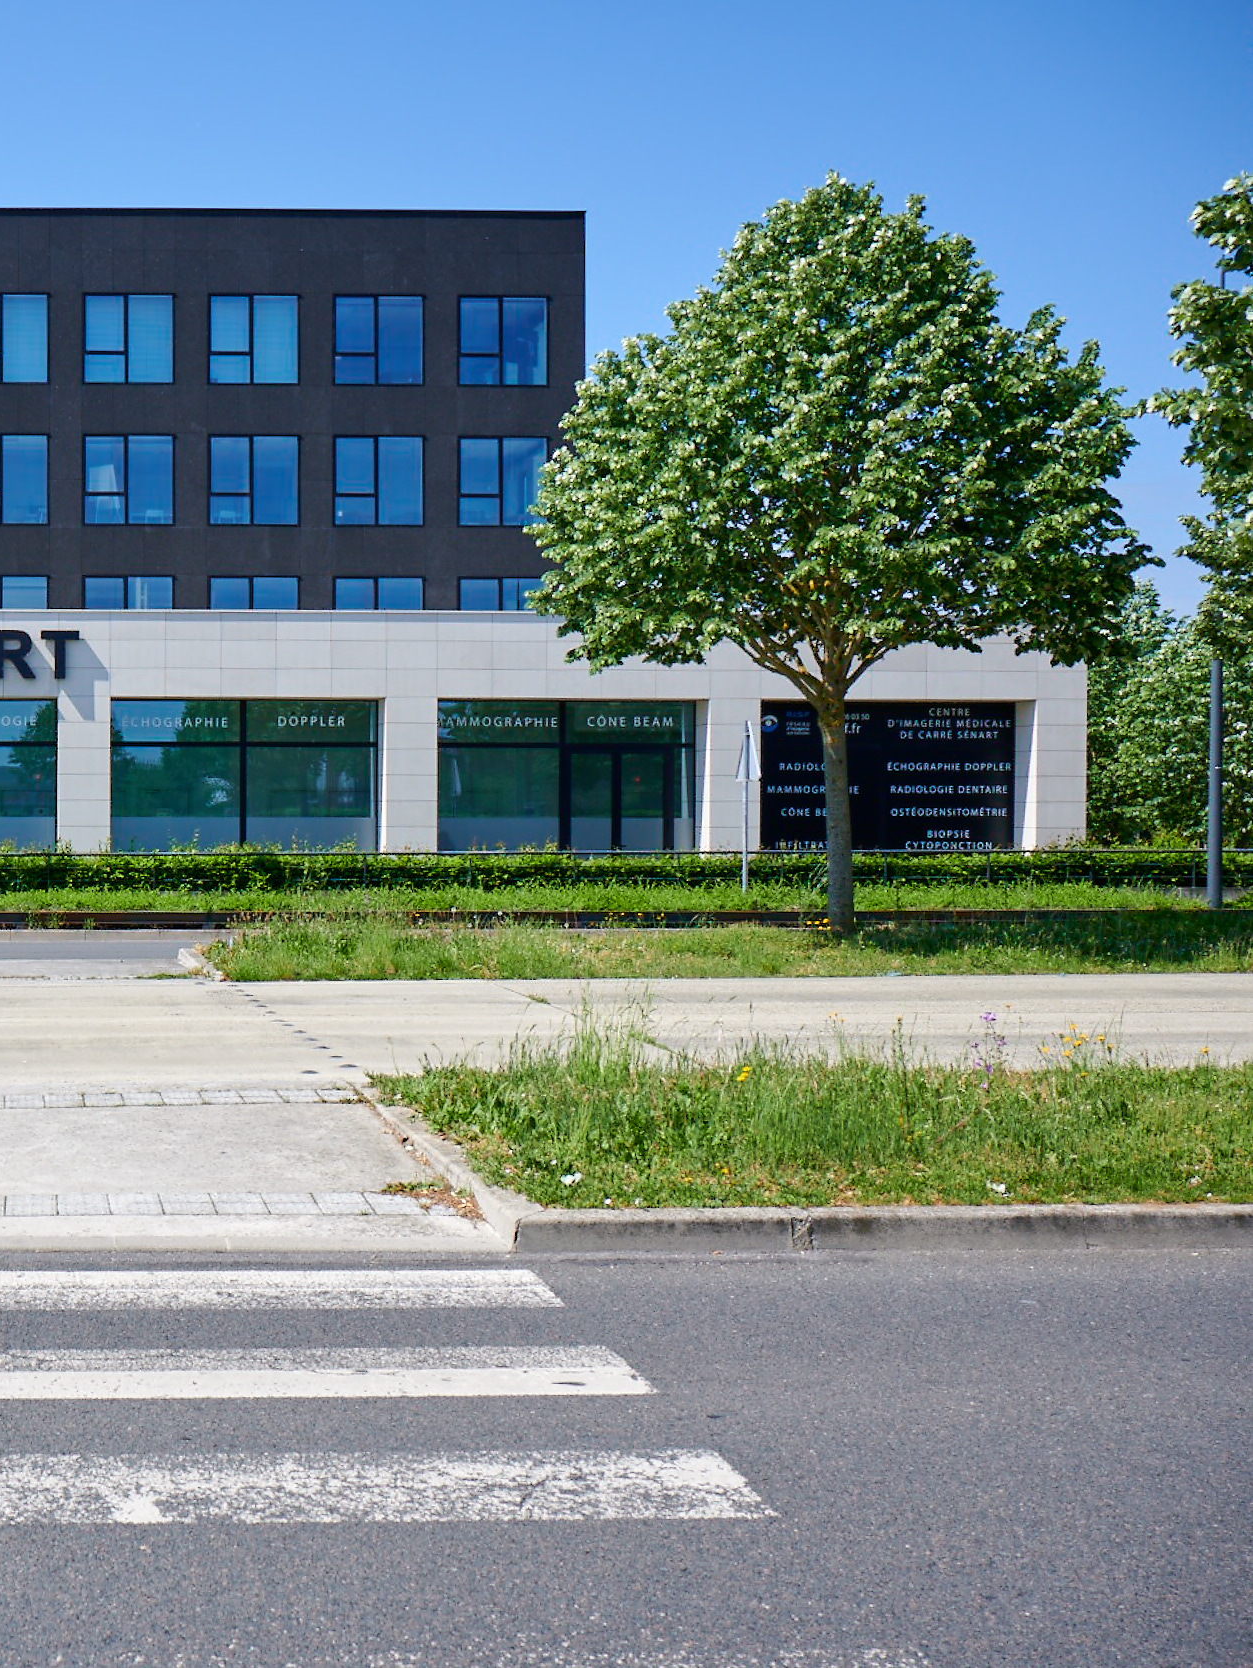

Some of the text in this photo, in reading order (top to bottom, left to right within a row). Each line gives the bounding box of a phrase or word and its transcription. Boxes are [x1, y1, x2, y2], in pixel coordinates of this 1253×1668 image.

[929, 707, 971, 717] CENTRE
[277, 715, 346, 728] DOPPLER
[587, 714, 674, 728] CÔNE BEAM
[887, 718, 1012, 729] D'IMAGERIE MÉDICALE
[900, 729, 999, 740] DE CARRÉ SÉNART
[887, 761, 1012, 772] ÉCHOGRAPHIE DOPPLER
[890, 784, 1008, 794] RADIOLOGIE DENTAIRE
[780, 807, 810, 817] CÔNE
[890, 806, 1008, 817] OSTÉODENSITOMÉTRIE
[927, 829, 970, 839] BIOPSIE
[905, 840, 993, 850] CYTOPONCTION
